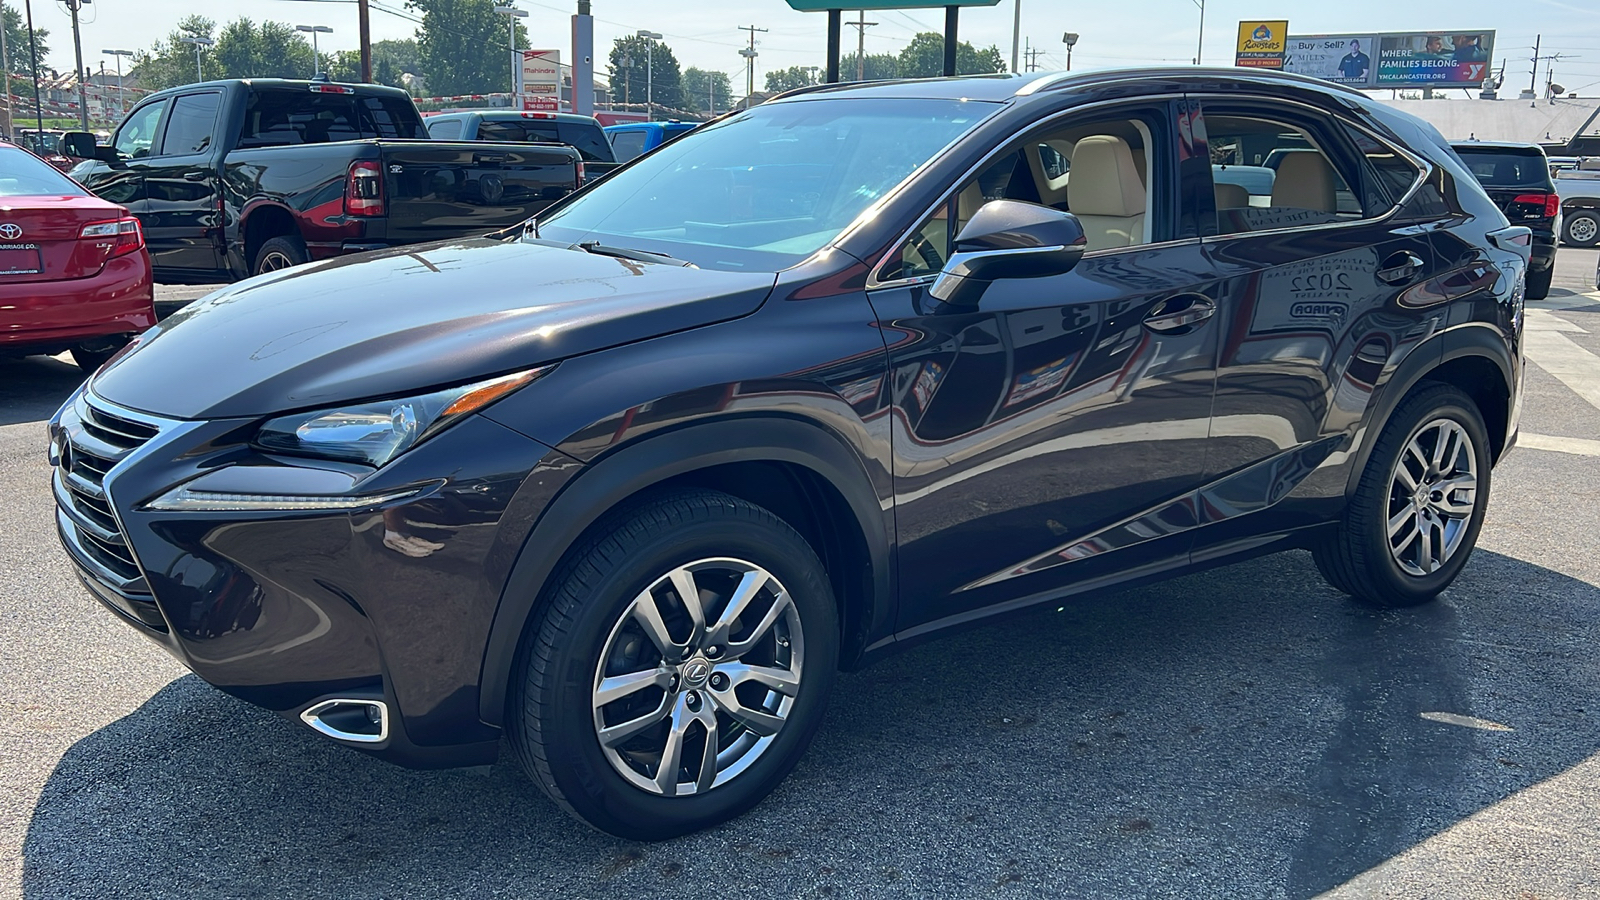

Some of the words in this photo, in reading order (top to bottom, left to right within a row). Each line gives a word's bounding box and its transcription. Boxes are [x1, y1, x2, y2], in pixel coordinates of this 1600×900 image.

[1243, 39, 1280, 51] Roosters
[1298, 42, 1315, 51] Buy
[1324, 41, 1345, 49] Sell?
[1380, 60, 1420, 68] FAMILIES
[1421, 60, 1460, 68] BELONG.
